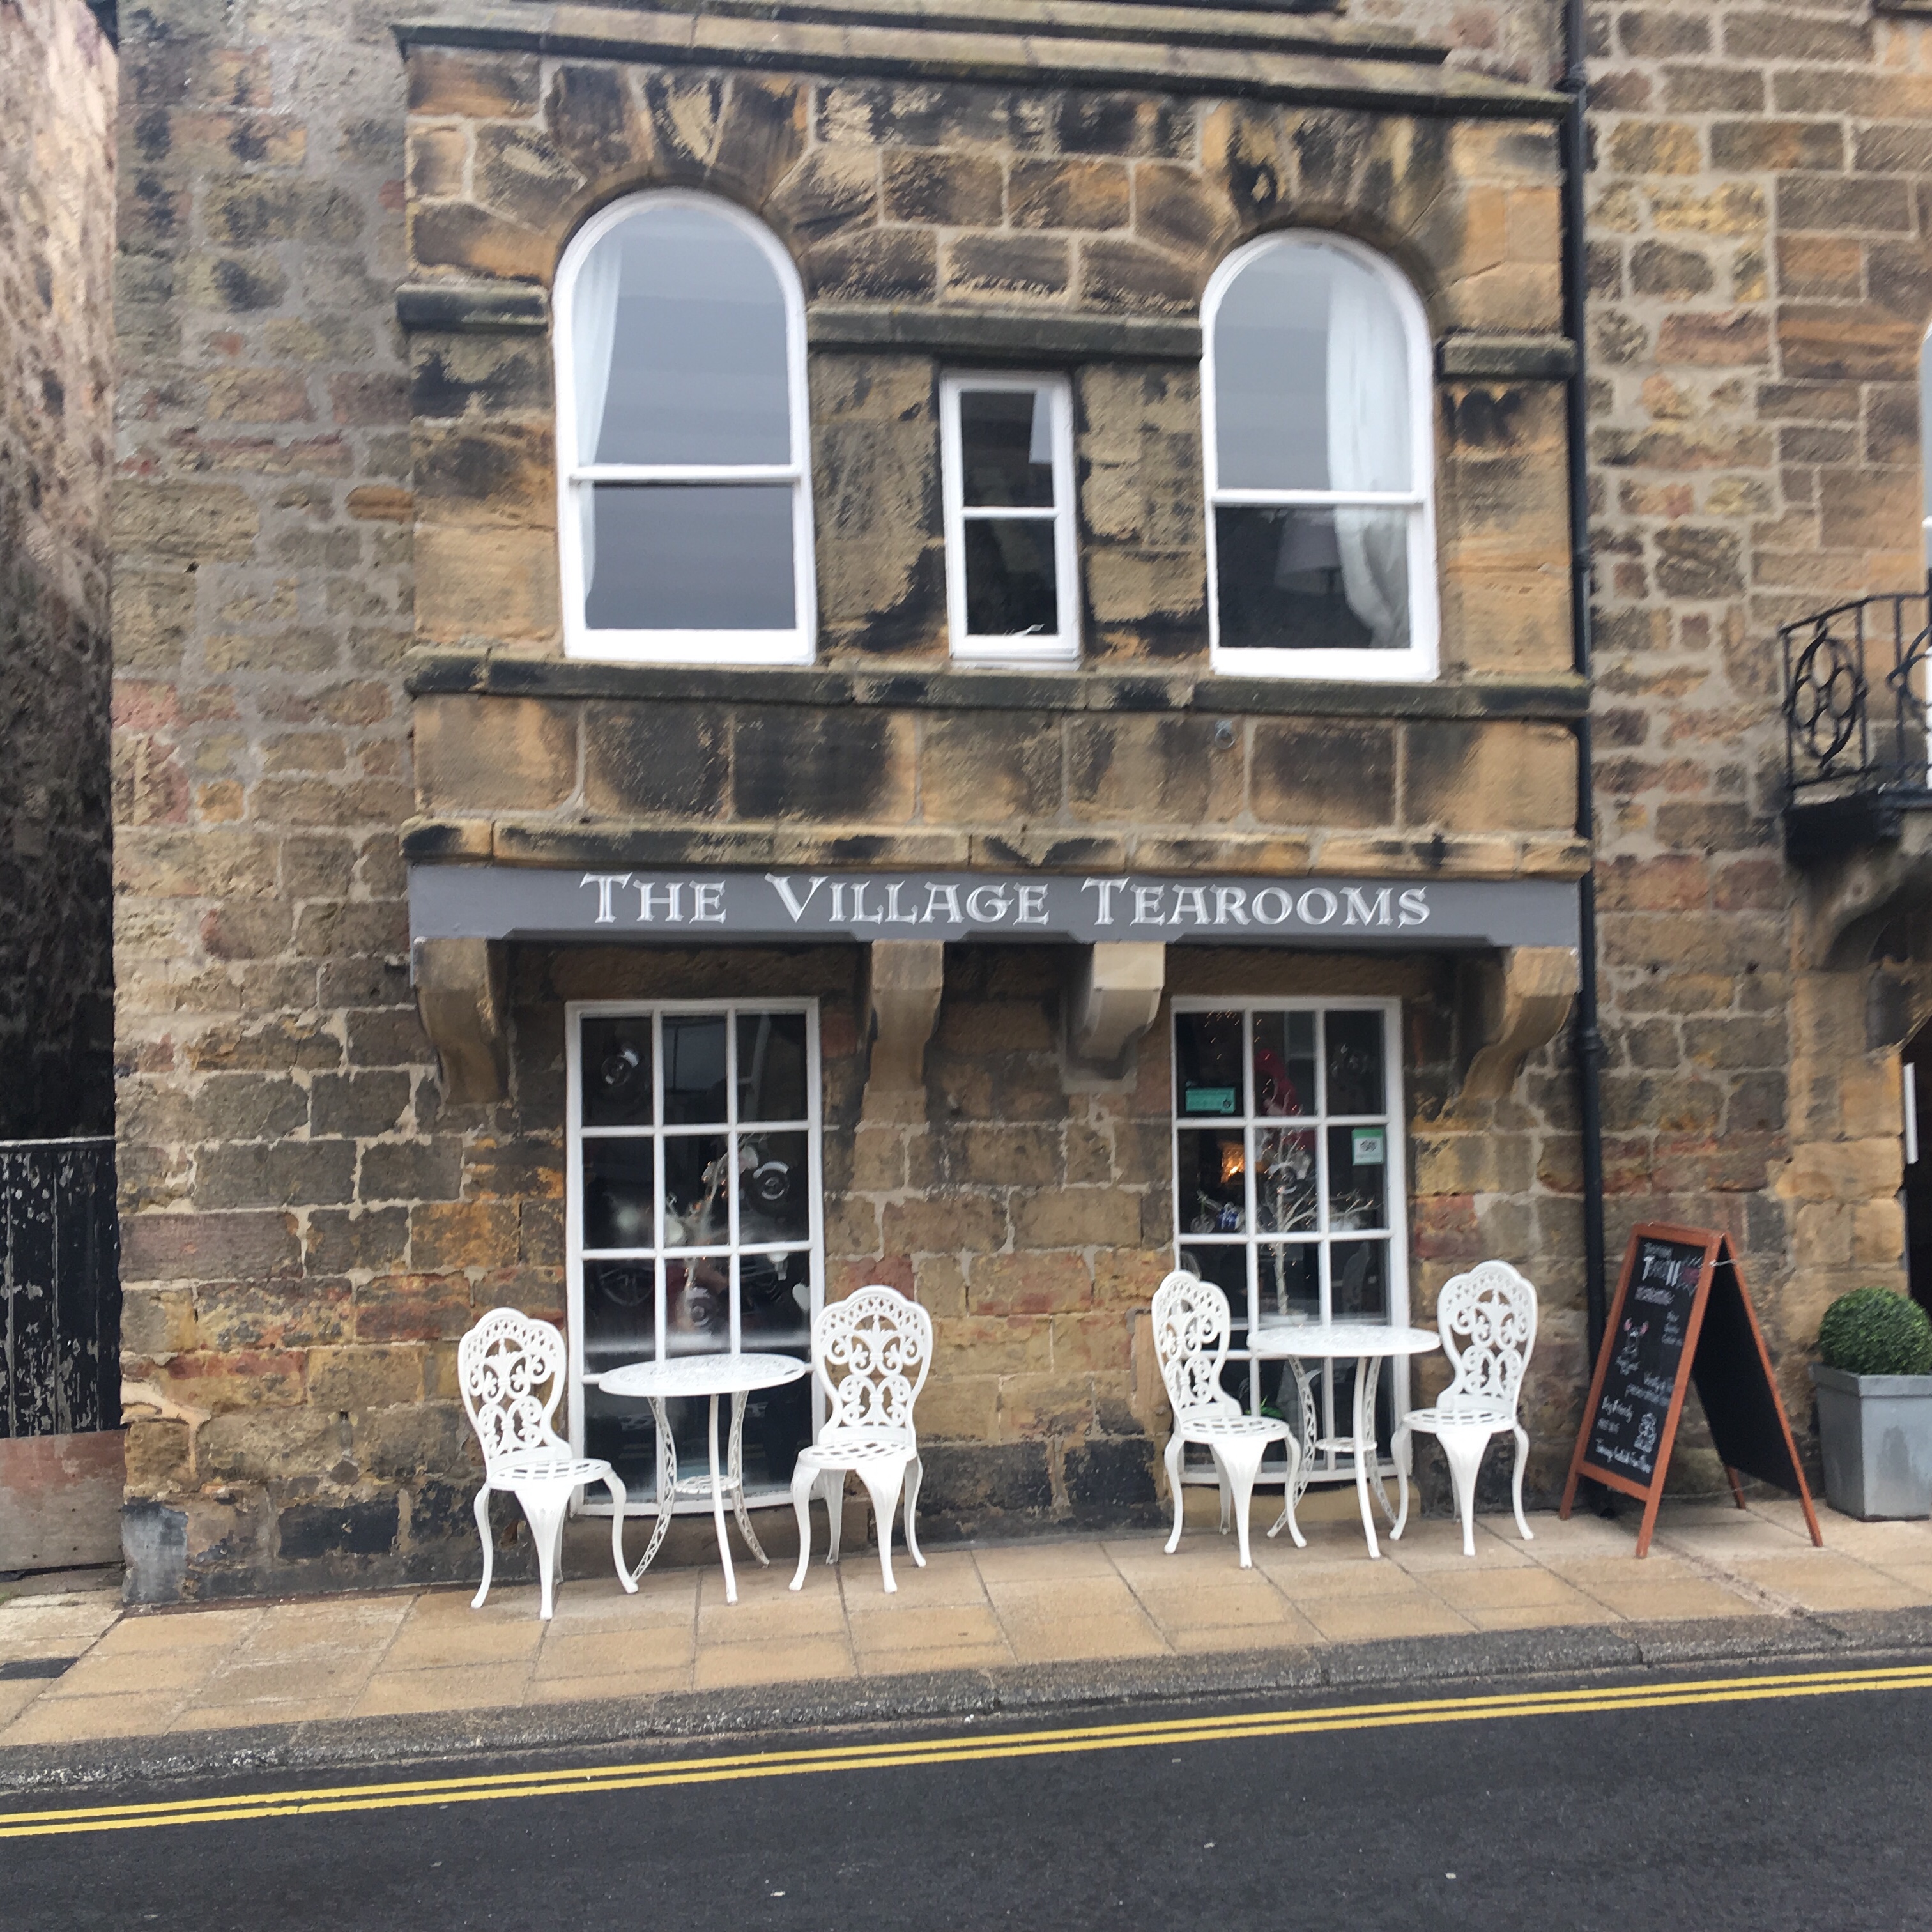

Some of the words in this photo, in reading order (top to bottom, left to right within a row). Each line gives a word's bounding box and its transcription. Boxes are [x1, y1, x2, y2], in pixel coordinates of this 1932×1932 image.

[579, 872, 727, 924] THE
[764, 873, 1050, 926] VILLAGE
[1080, 876, 1431, 928] TEAROOMS
